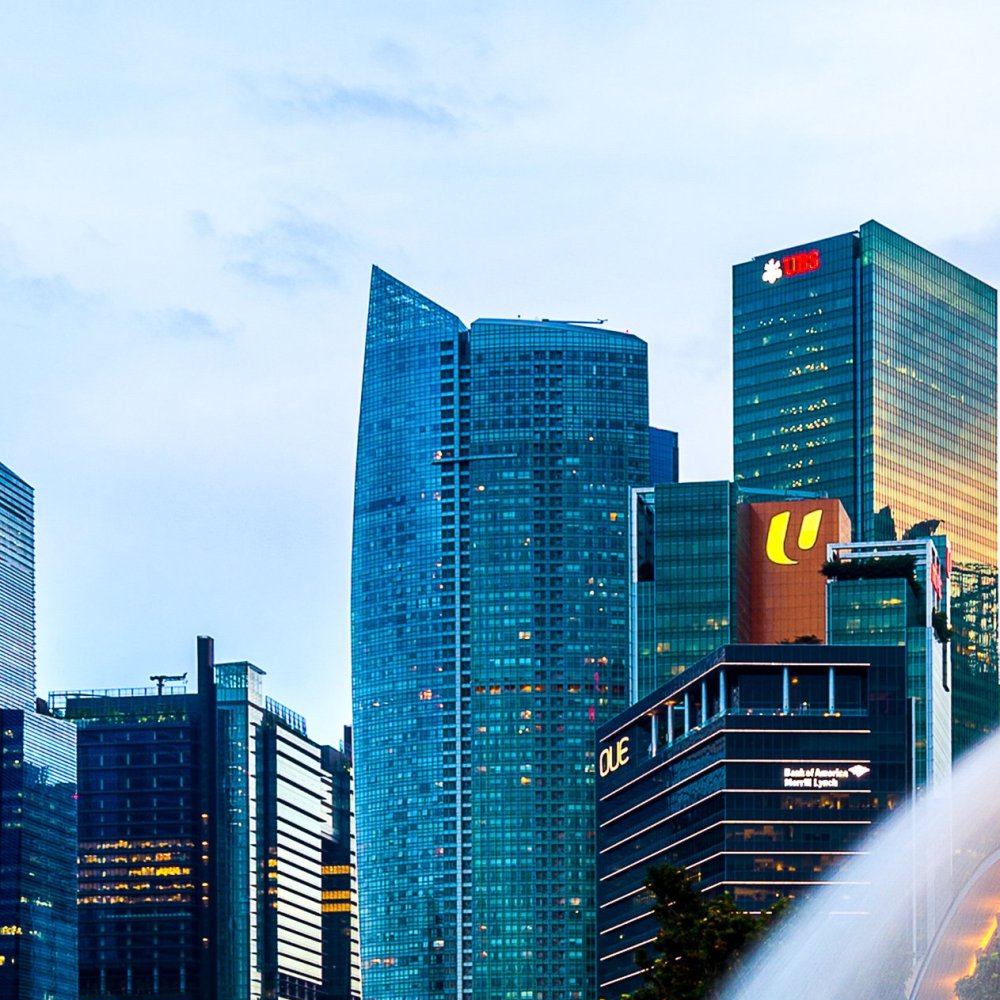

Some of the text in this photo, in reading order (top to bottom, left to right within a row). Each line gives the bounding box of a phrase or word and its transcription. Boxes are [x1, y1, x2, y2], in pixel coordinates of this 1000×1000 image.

[782, 249, 820, 277] UBS
[599, 736, 630, 777] OUE
[783, 767, 849, 778] Bank of America
[784, 778, 839, 788] Merrill Lynch
